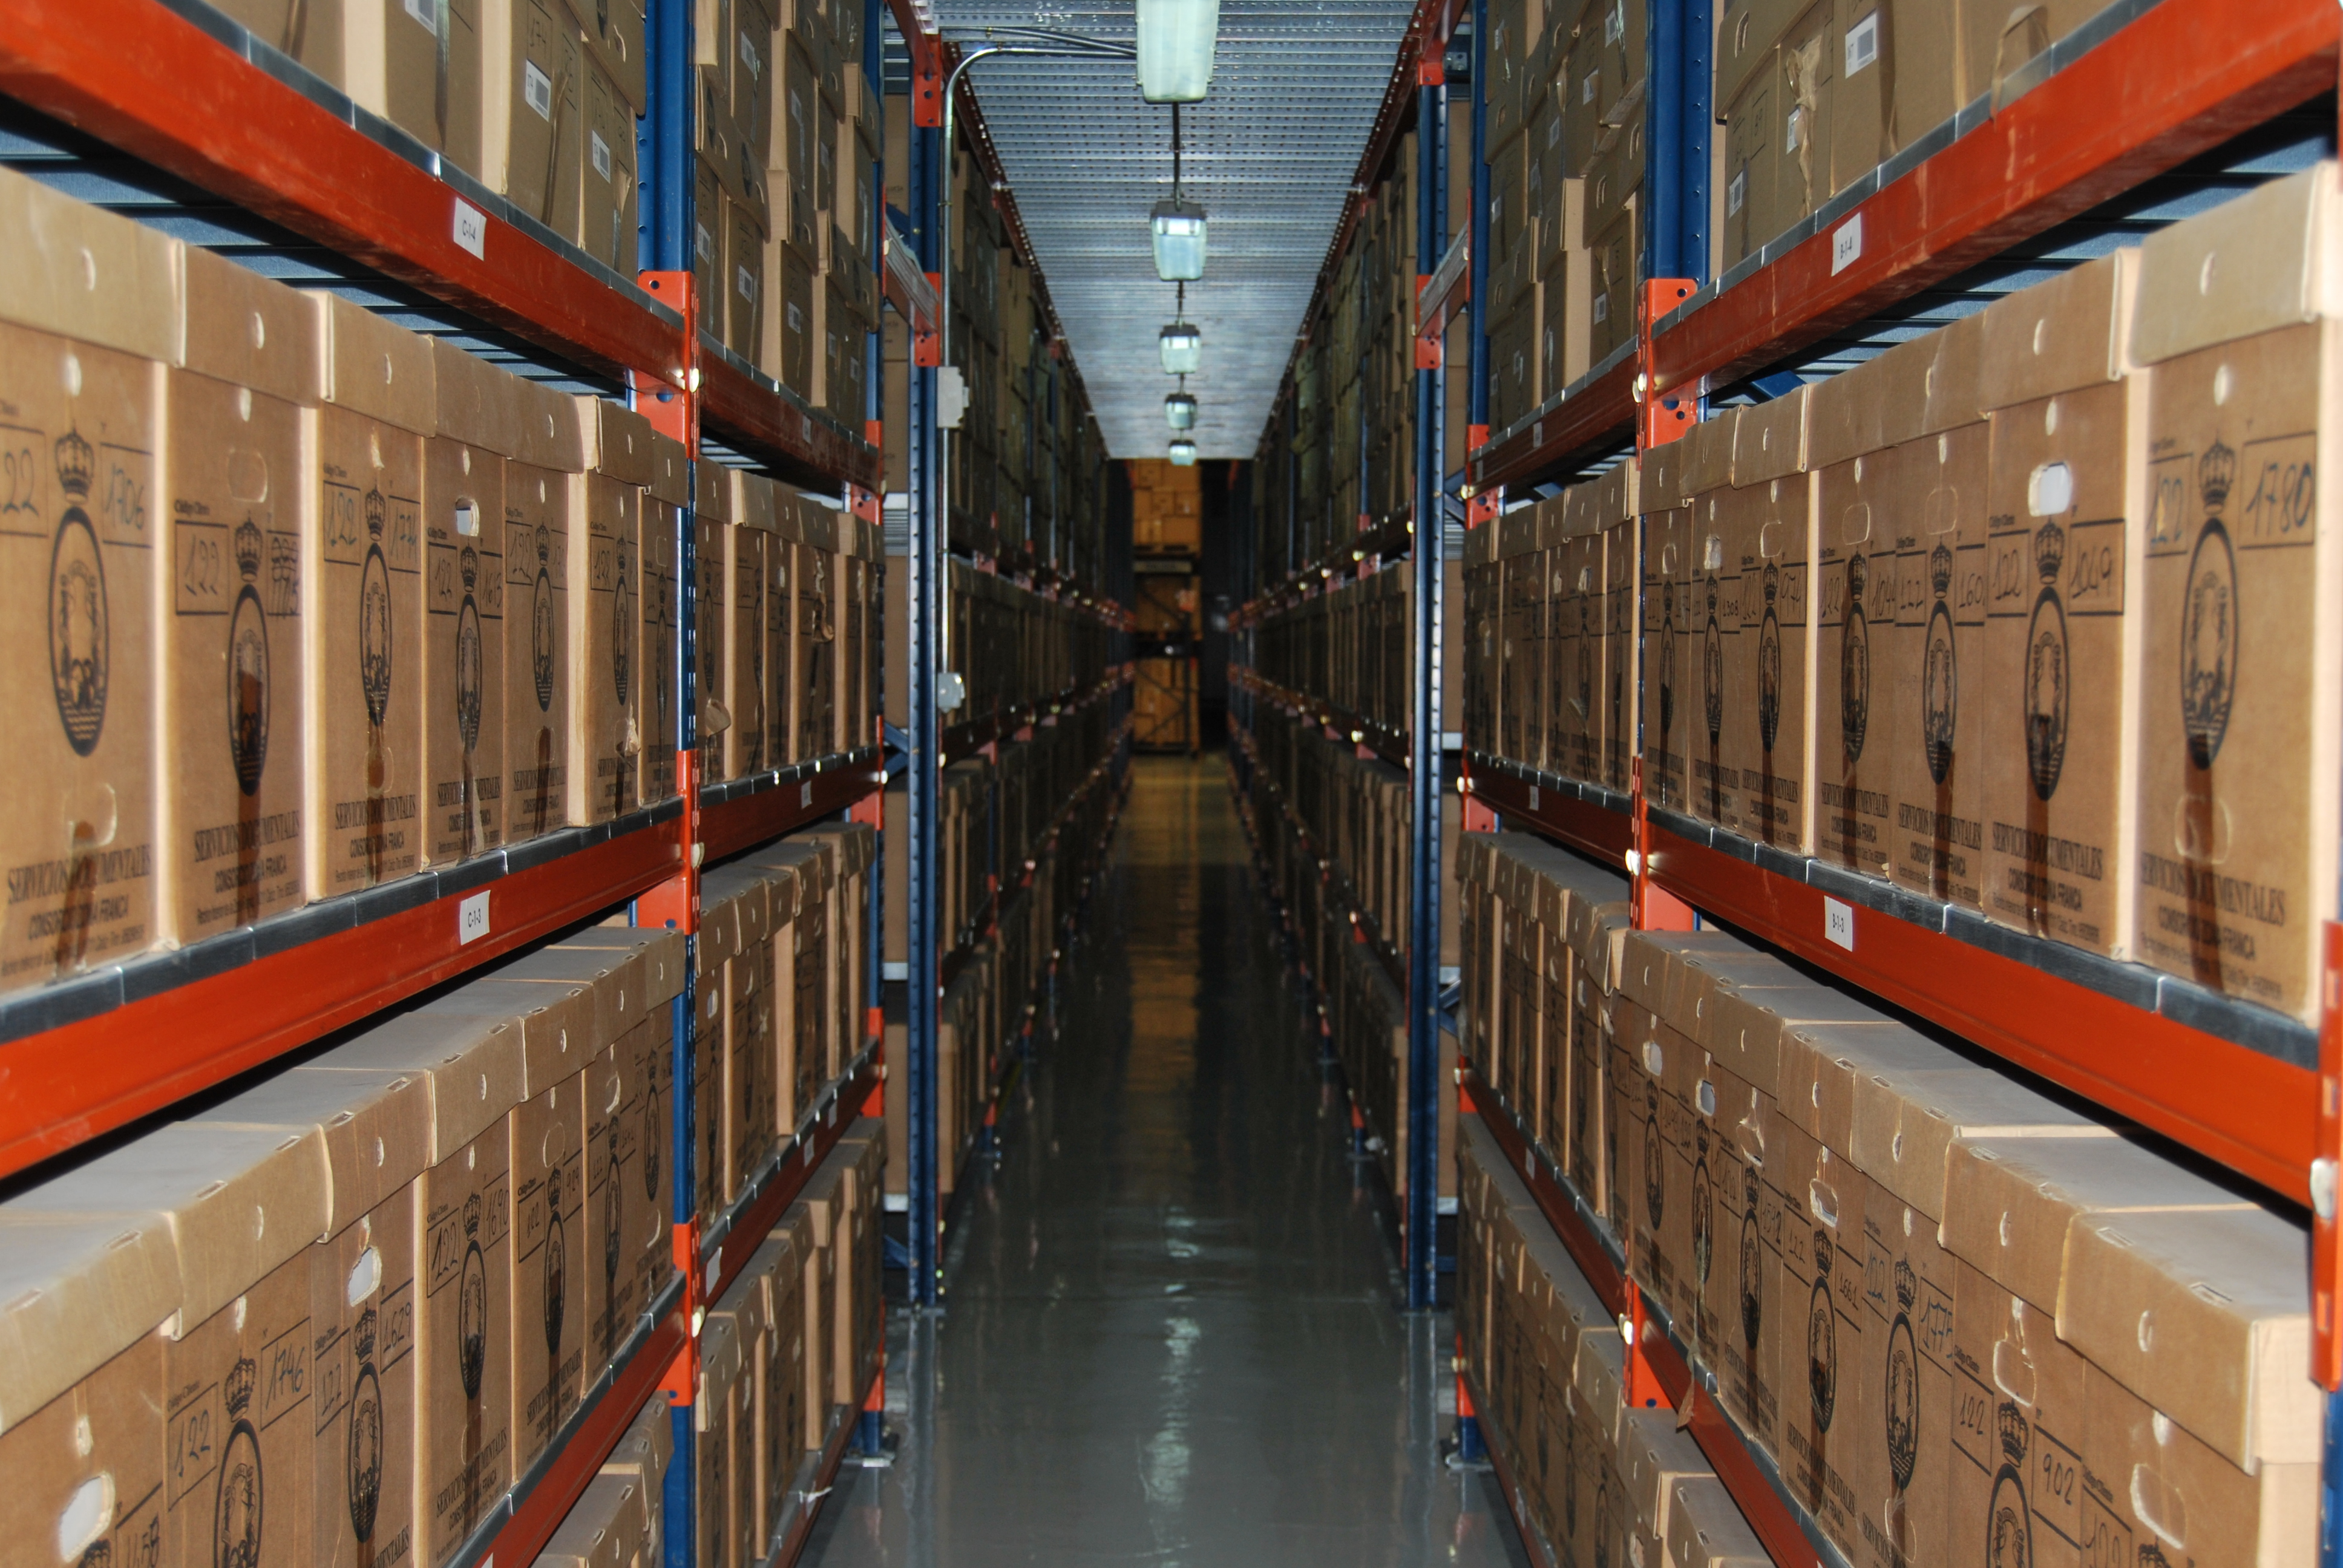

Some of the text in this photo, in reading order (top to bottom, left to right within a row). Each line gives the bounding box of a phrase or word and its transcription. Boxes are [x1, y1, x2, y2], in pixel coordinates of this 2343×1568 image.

[0, 449, 39, 516] 22
[2246, 460, 2313, 537] 1780
[327, 491, 358, 547] 122
[185, 535, 220, 596] 122
[435, 557, 452, 602] 122
[510, 531, 533, 583] 122
[1993, 546, 2022, 600] 122
[1820, 577, 1840, 619] 122
[1900, 575, 1924, 610] 122
[486, 1188, 510, 1242] 1690
[431, 1221, 458, 1282] 122
[1789, 1229, 1806, 1264] 122
[1838, 1272, 1859, 1312] 1661
[1865, 1251, 1886, 1304] 122
[383, 1301, 412, 1353] 1629
[266, 1342, 305, 1410] 1746
[321, 1362, 342, 1417] 122
[1959, 1391, 1985, 1436] 122
[175, 1408, 211, 1477] 122
[2042, 1452, 2074, 1506] 902
